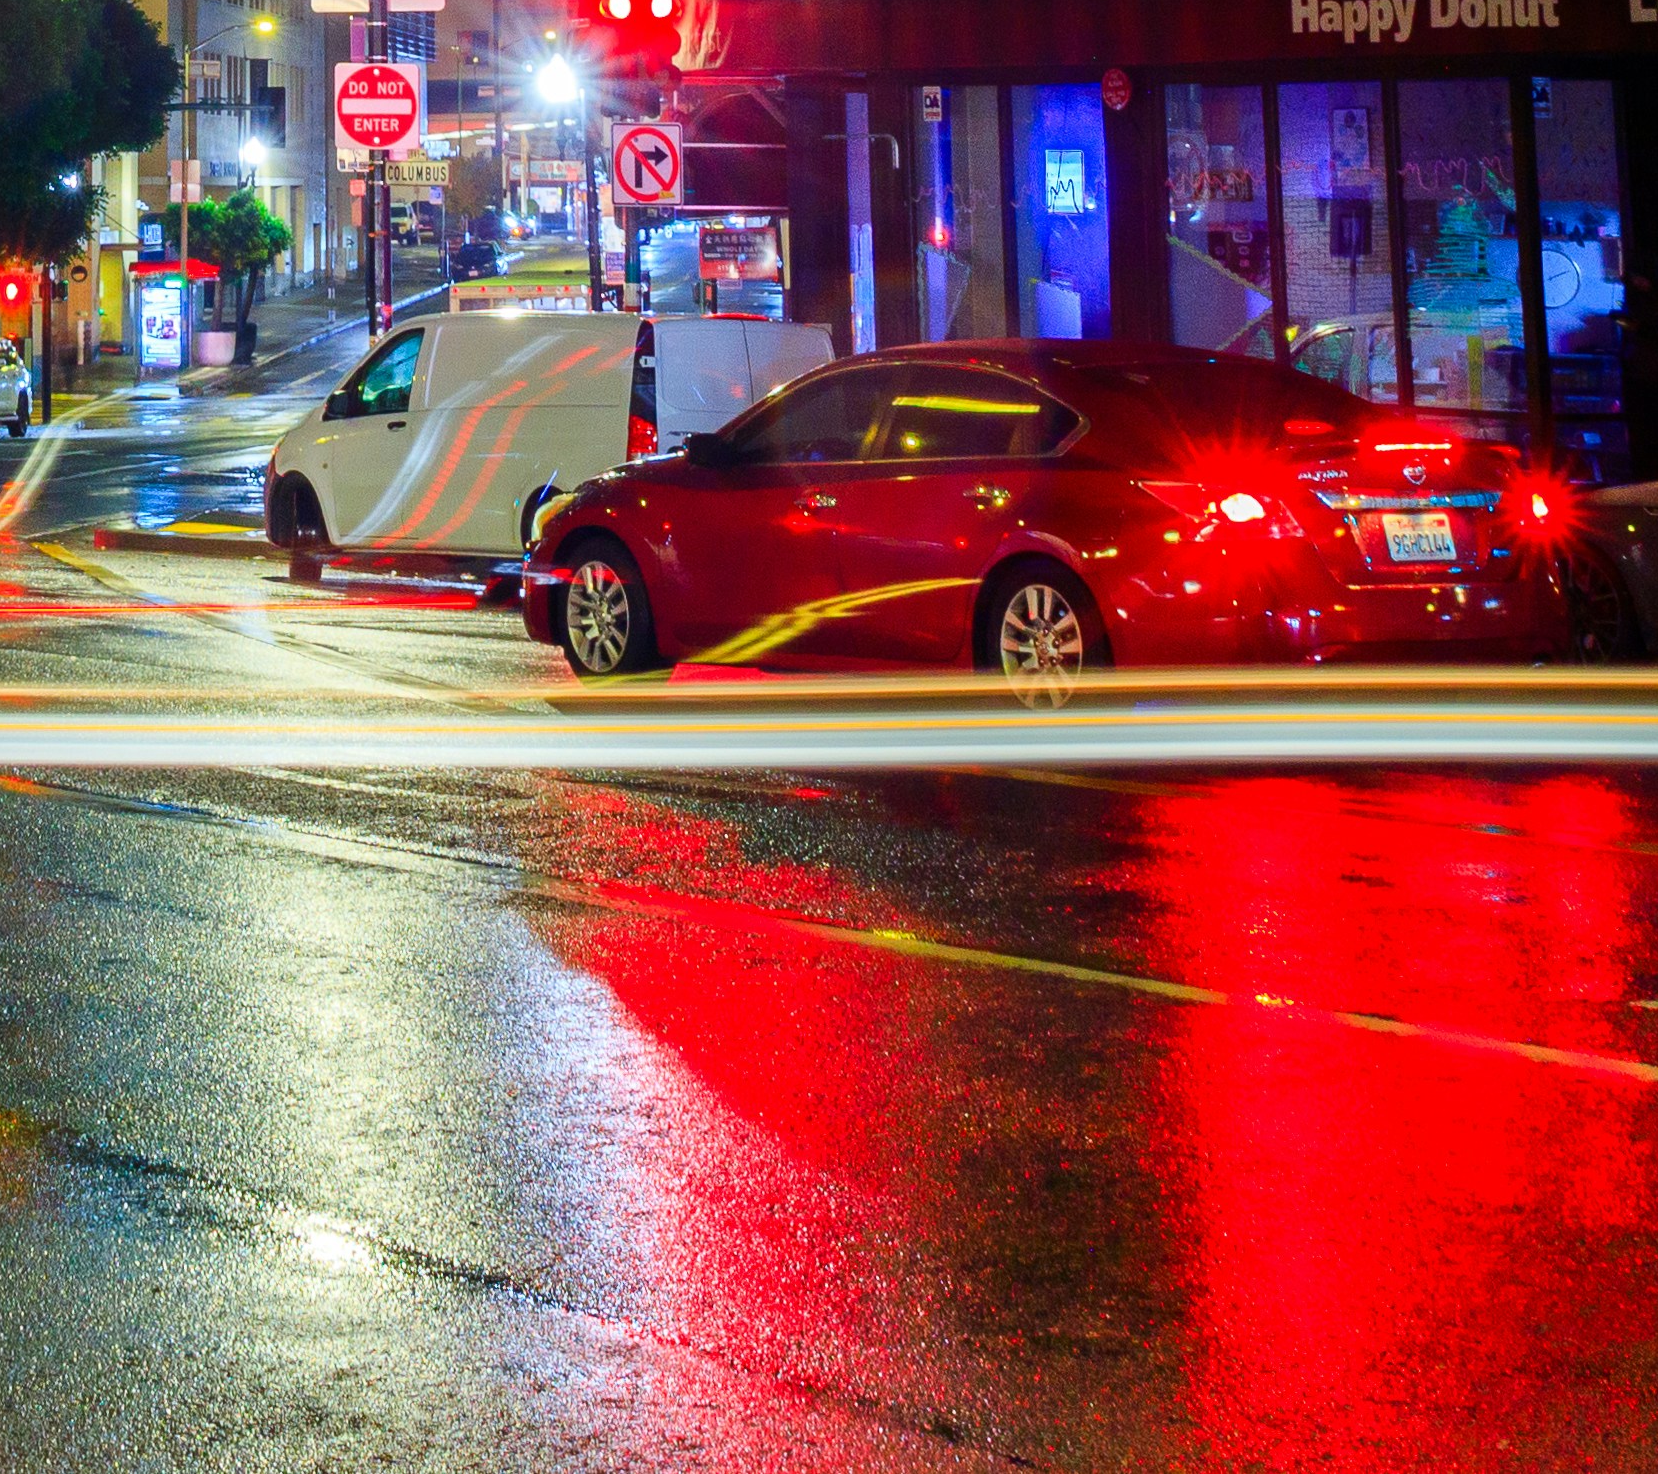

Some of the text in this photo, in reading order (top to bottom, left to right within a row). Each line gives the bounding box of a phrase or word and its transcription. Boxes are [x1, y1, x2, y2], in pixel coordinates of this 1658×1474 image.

[348, 81, 405, 95] DO NOT
[353, 118, 400, 132] ENTER
[387, 165, 447, 181] COLUMBUS
[1392, 533, 1452, 553] 9GHC144
